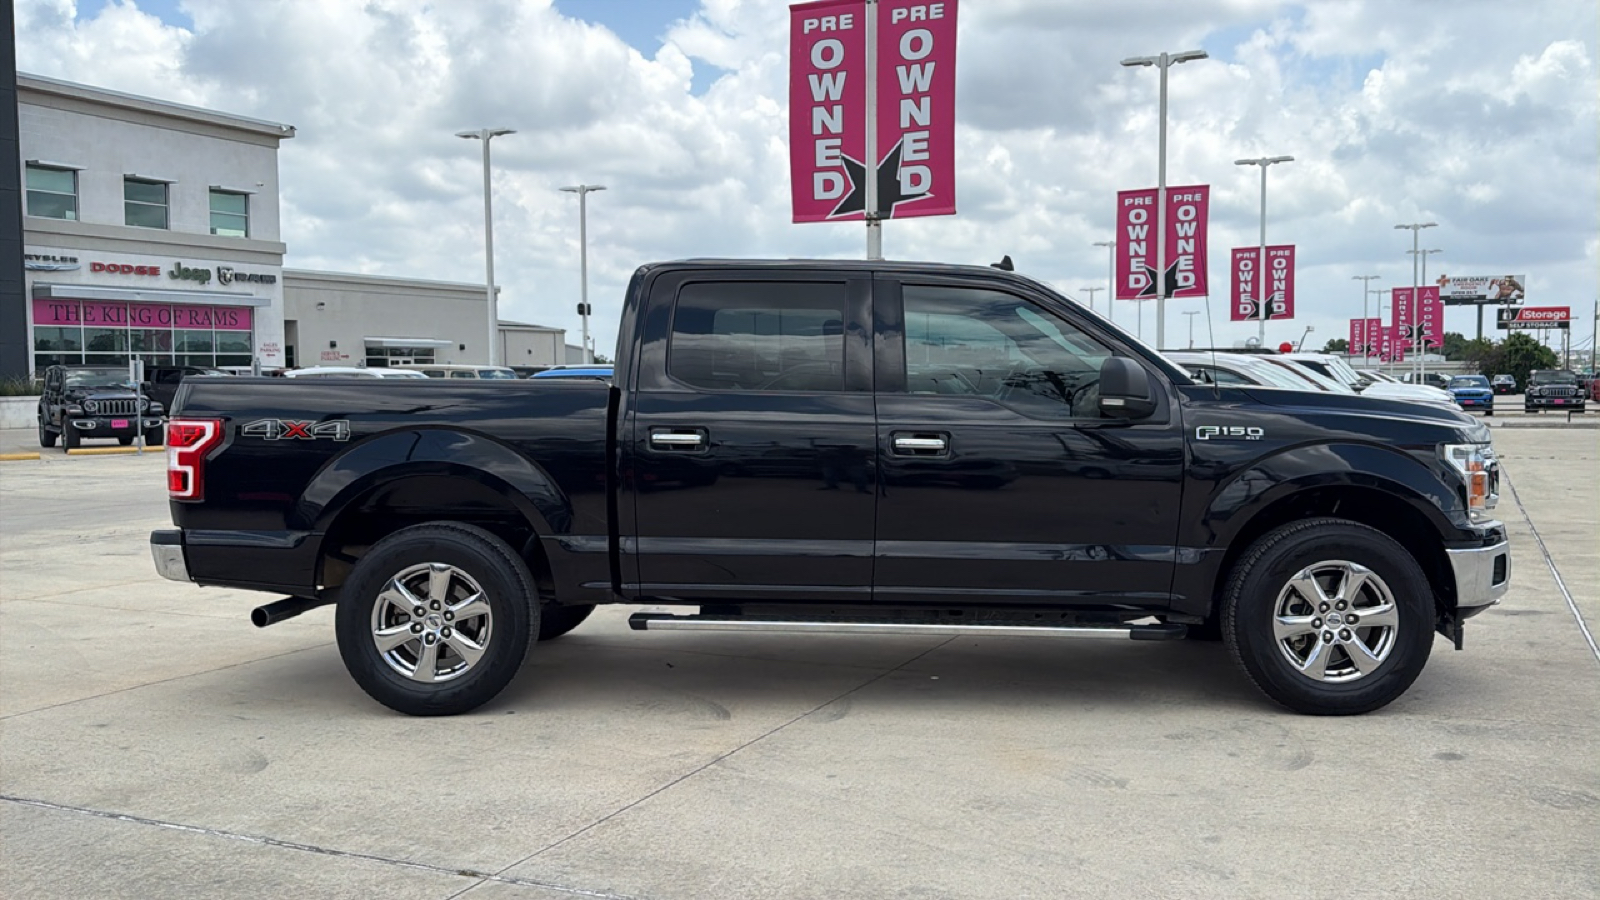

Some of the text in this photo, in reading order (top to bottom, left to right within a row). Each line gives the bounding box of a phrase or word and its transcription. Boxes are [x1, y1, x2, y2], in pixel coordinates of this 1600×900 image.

[803, 14, 854, 34] PRE
[892, 4, 944, 24] PRE
[808, 38, 847, 200] OWNED
[896, 28, 935, 195] OWNED
[1124, 196, 1153, 206] PRE
[1173, 193, 1202, 203] PRE
[1127, 208, 1149, 289] OWNED
[1175, 205, 1197, 287] OWNED
[90, 261, 161, 276] DODGE
[168, 262, 211, 285] Jeep
[234, 272, 276, 285] RAM
[1239, 260, 1253, 314] OWNED
[1272, 258, 1287, 312] OWNED
[49, 303, 239, 327] THE KING OF RAMS
[1424, 299, 1433, 335] DODGE
[1522, 309, 1567, 320] iStorage
